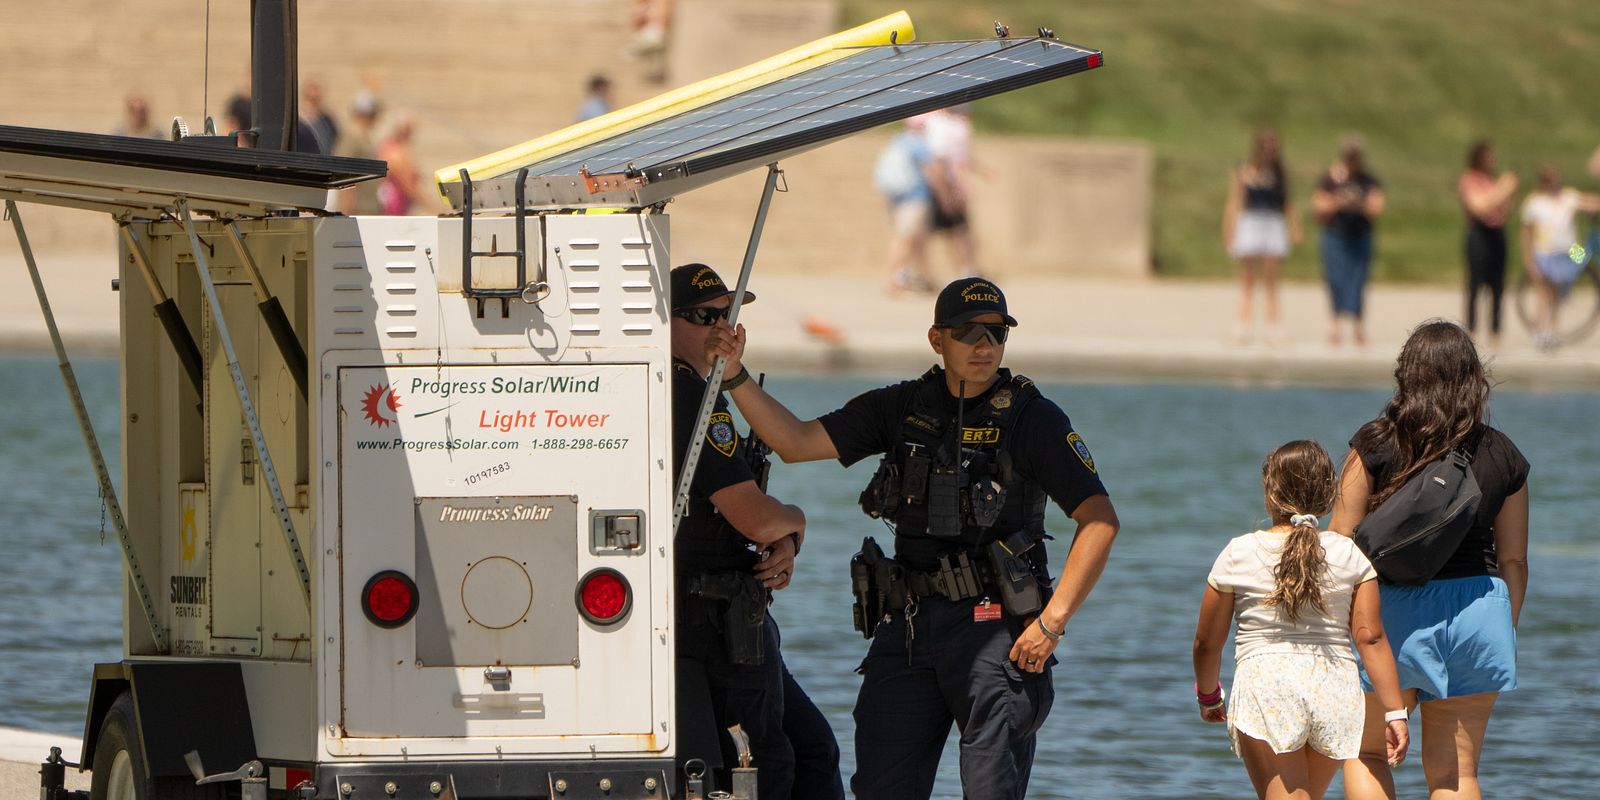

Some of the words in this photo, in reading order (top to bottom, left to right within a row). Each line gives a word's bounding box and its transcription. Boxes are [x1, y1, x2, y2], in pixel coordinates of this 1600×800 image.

[697, 278, 721, 289] POLI
[964, 293, 999, 303] POLICE
[411, 377, 486, 398] Progress
[491, 376, 600, 394] Solar/Wind
[479, 410, 537, 432] Light
[544, 410, 610, 428] Tower
[708, 415, 730, 425] OLICE
[357, 438, 519, 453] www.ProgressSolar.com
[532, 438, 629, 450] 1-888-298-6657
[464, 461, 511, 486] 10197583
[439, 505, 511, 523] Progress
[511, 504, 554, 521] Solar
[170, 576, 207, 604] SUNBELT
[175, 606, 202, 618] RENTALS
